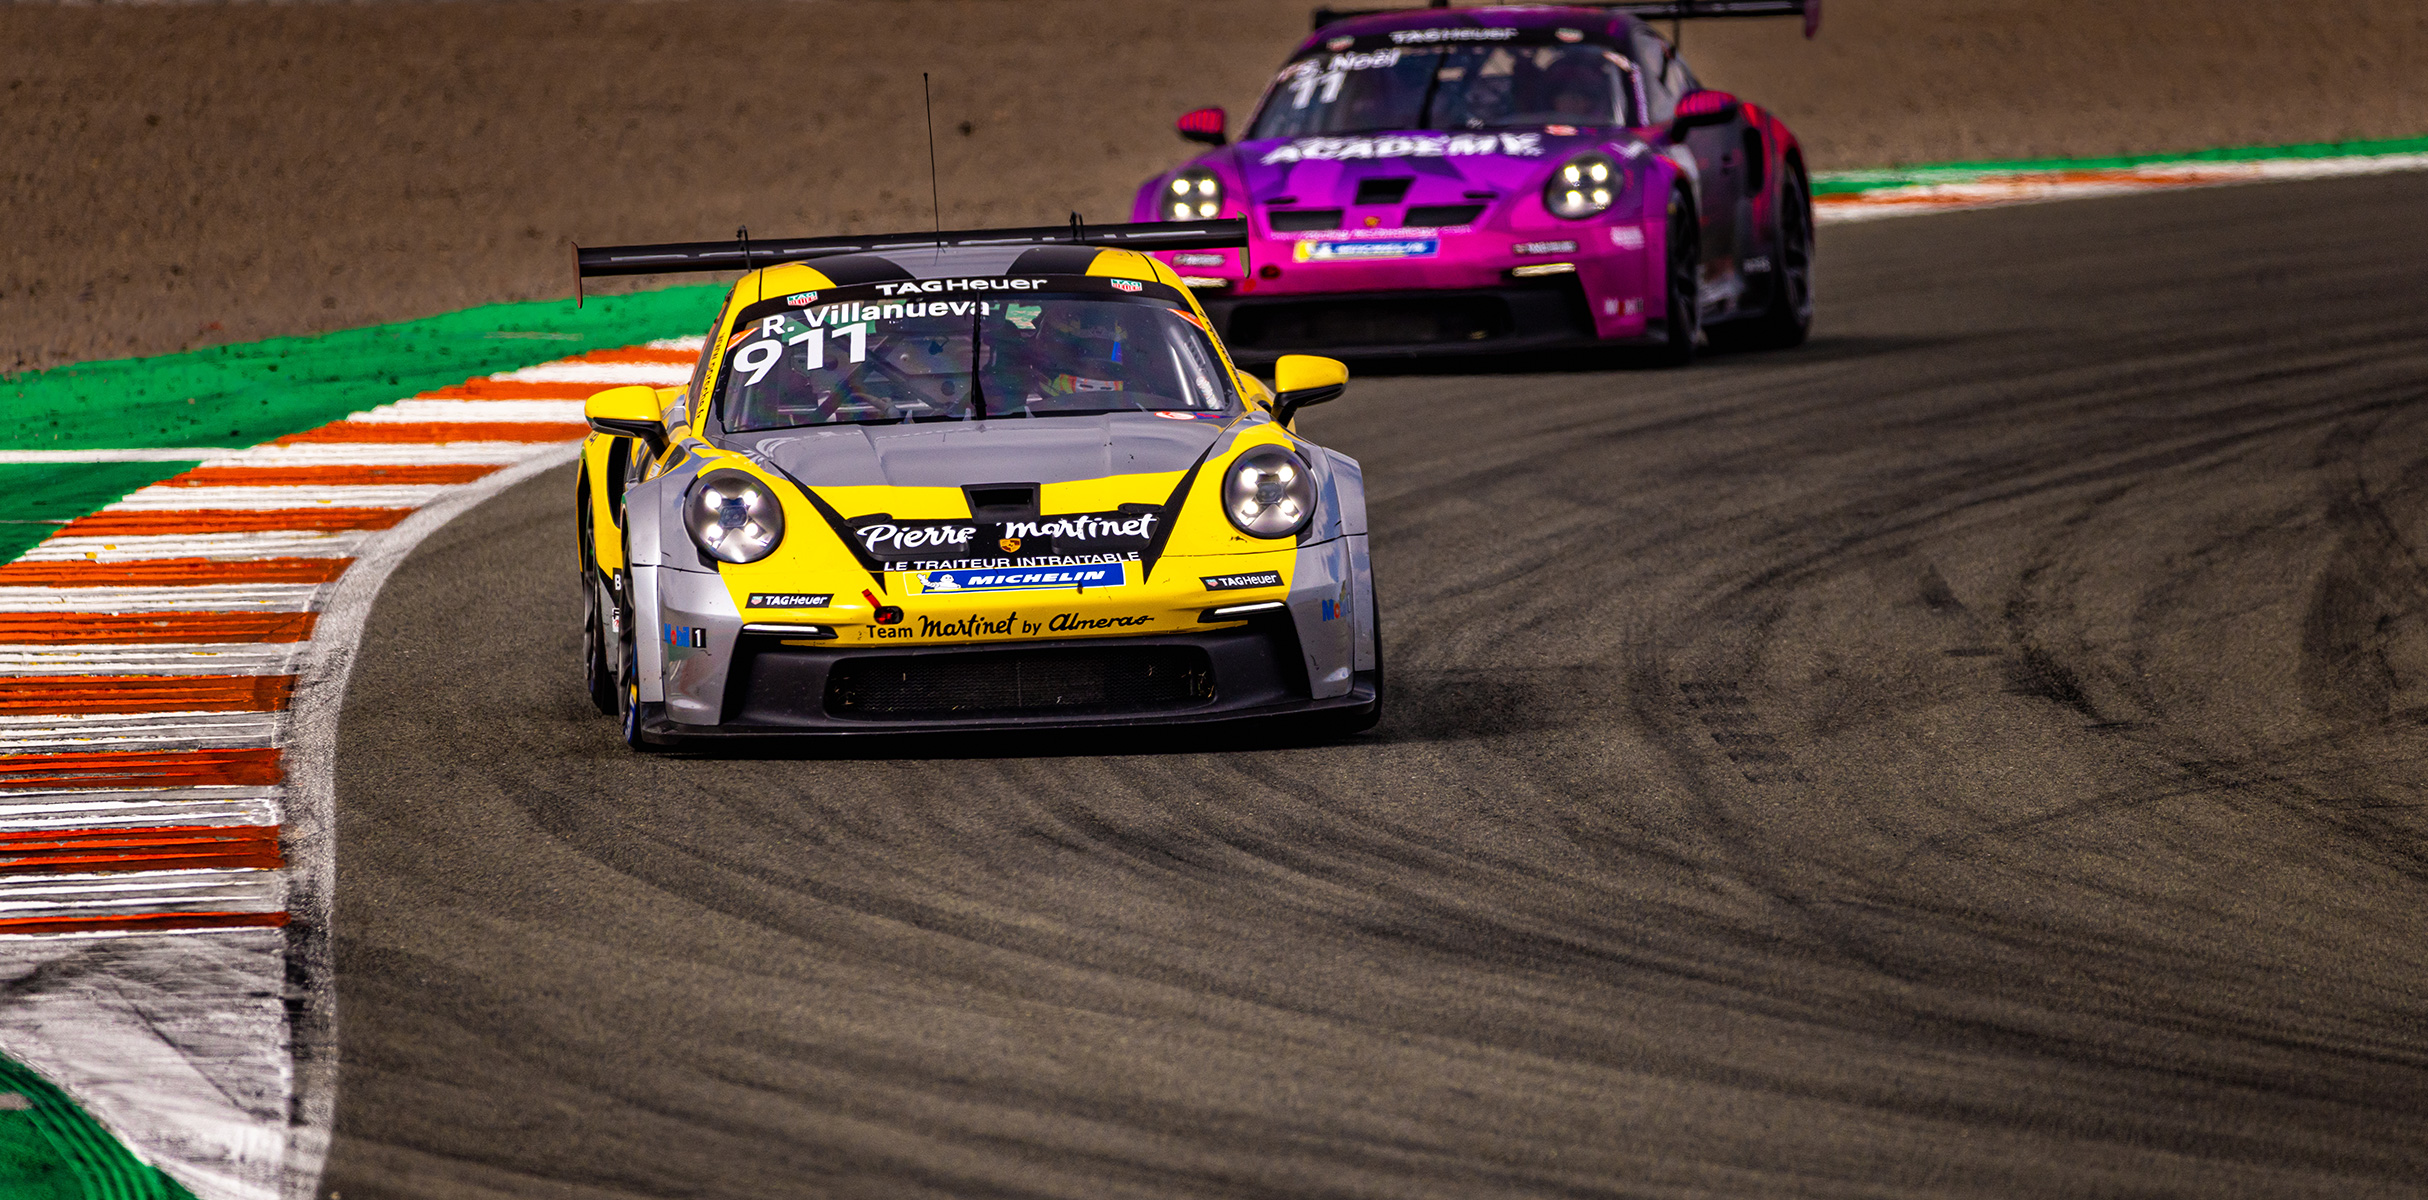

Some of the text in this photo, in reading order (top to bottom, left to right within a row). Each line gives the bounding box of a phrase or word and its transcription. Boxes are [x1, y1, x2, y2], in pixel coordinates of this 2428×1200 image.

[762, 301, 990, 339] R. Villanueva
[733, 322, 867, 387] 911
[856, 524, 977, 552] Pierre
[884, 551, 1141, 572] LE TRAITEUR INTRAITABLE
[967, 570, 1106, 586] MICHELIN
[694, 629, 702, 647] 1
[866, 624, 913, 639] Team
[1022, 620, 1042, 636] by
[1049, 612, 1155, 632] Almeras
